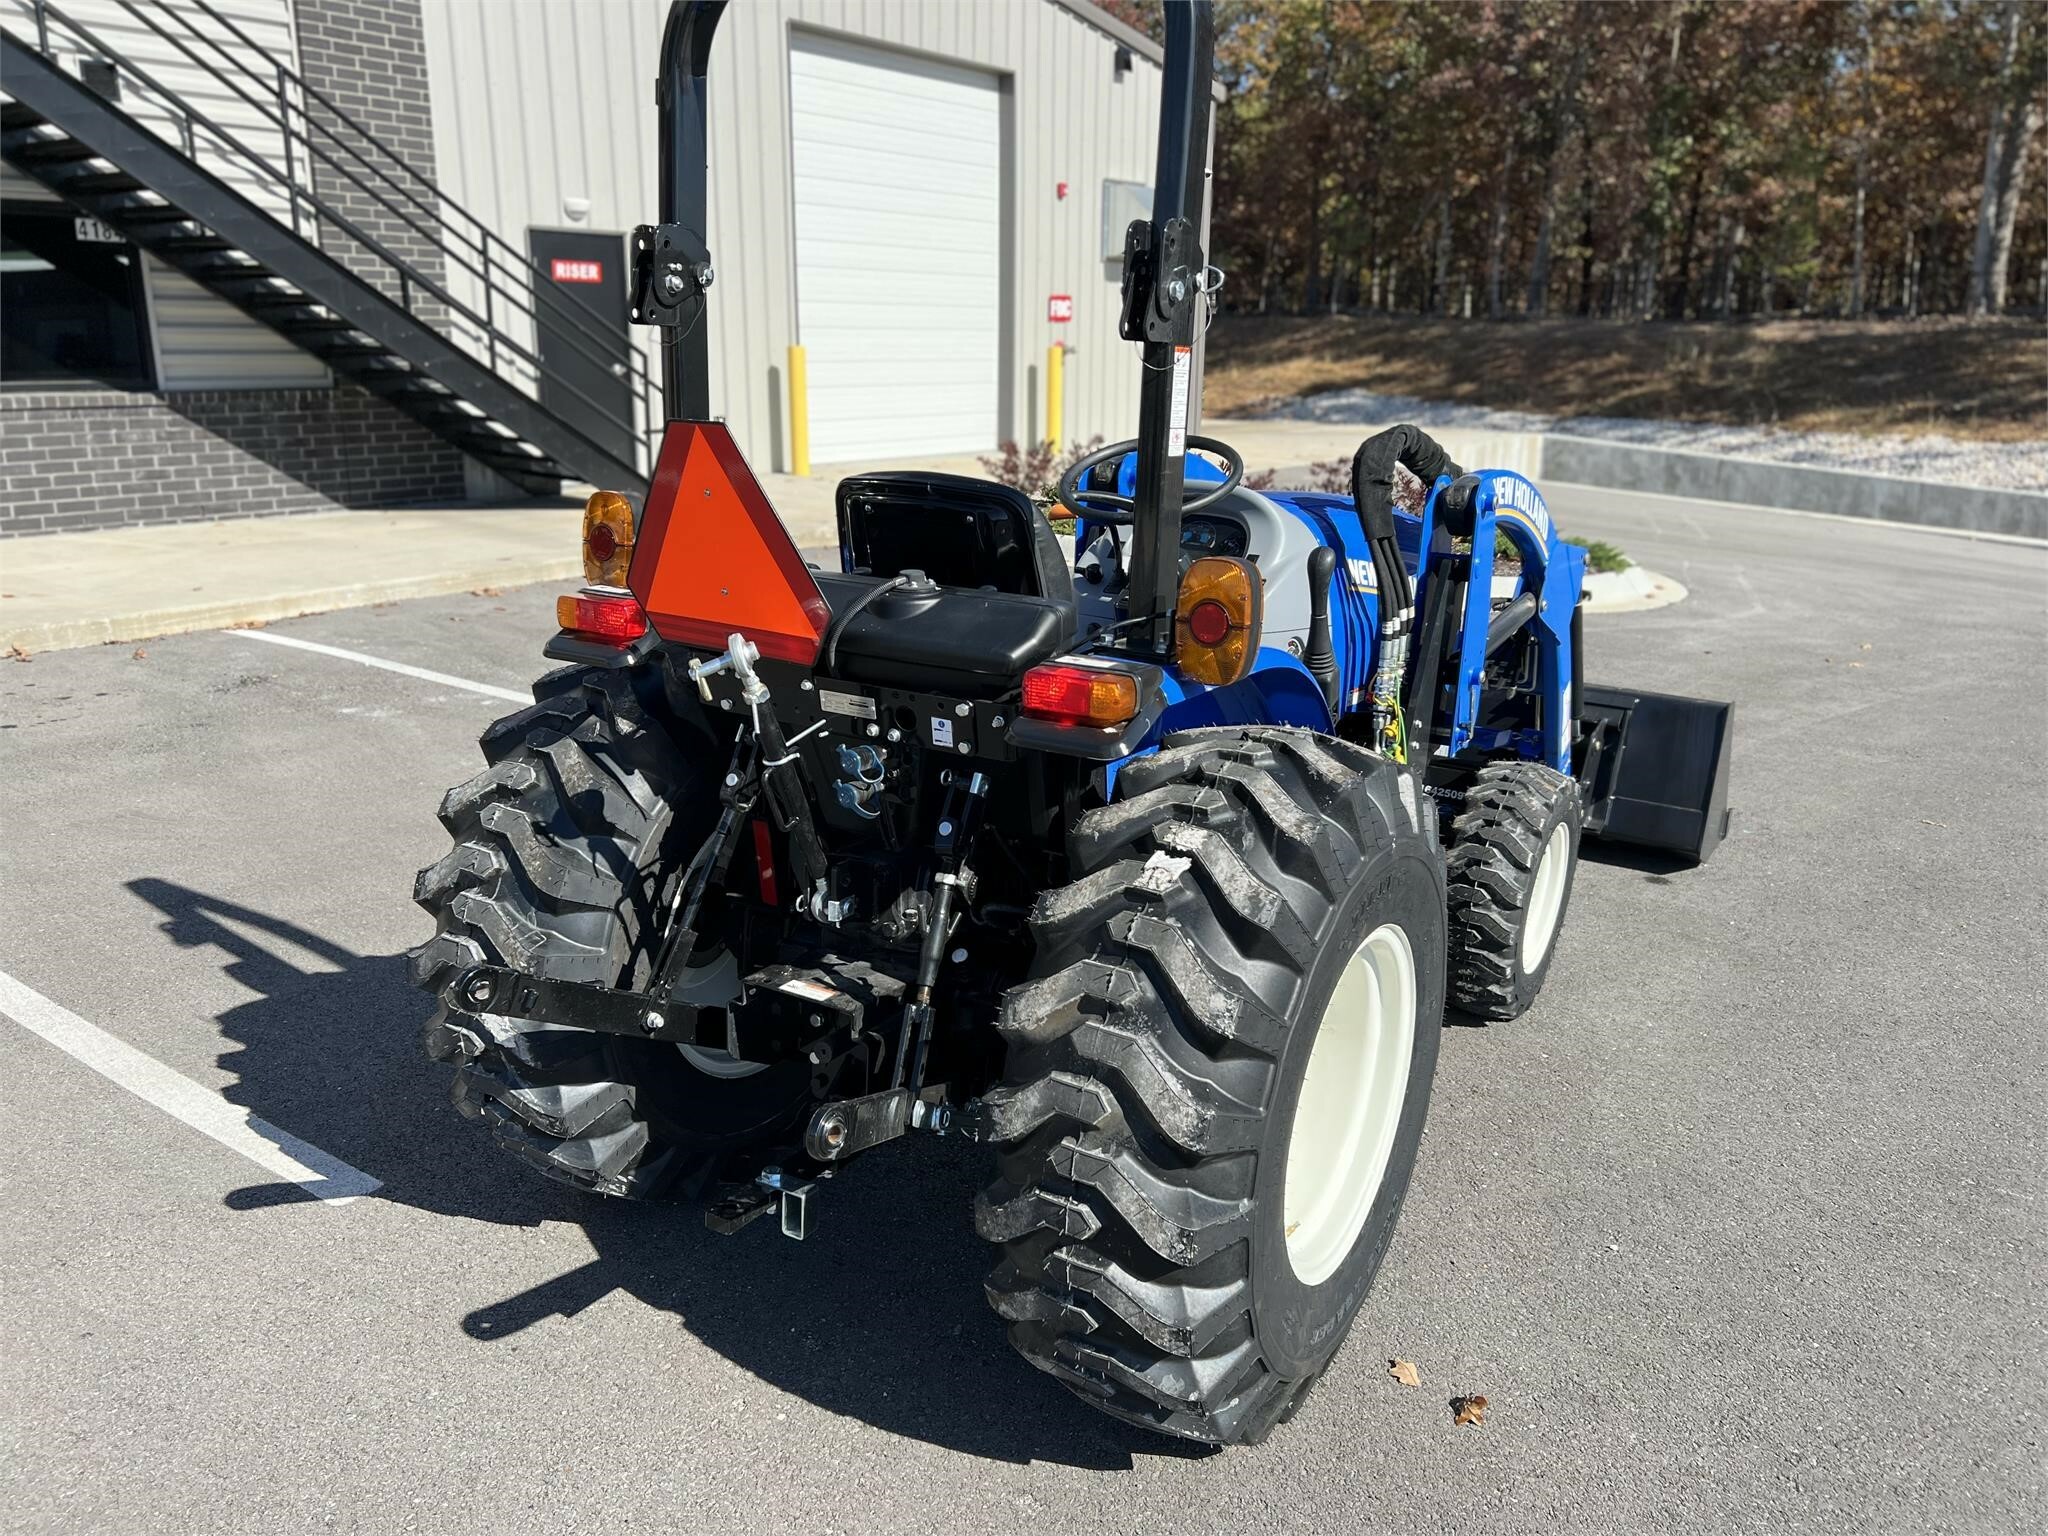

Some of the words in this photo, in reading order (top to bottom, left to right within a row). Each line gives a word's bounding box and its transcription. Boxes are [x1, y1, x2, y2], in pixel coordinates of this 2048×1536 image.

[78, 220, 124, 240] 418
[556, 262, 598, 279] RISER
[1493, 476, 1516, 505] NEW
[1514, 479, 1549, 541] HOLLAND
[1422, 784, 1464, 800] 642509
